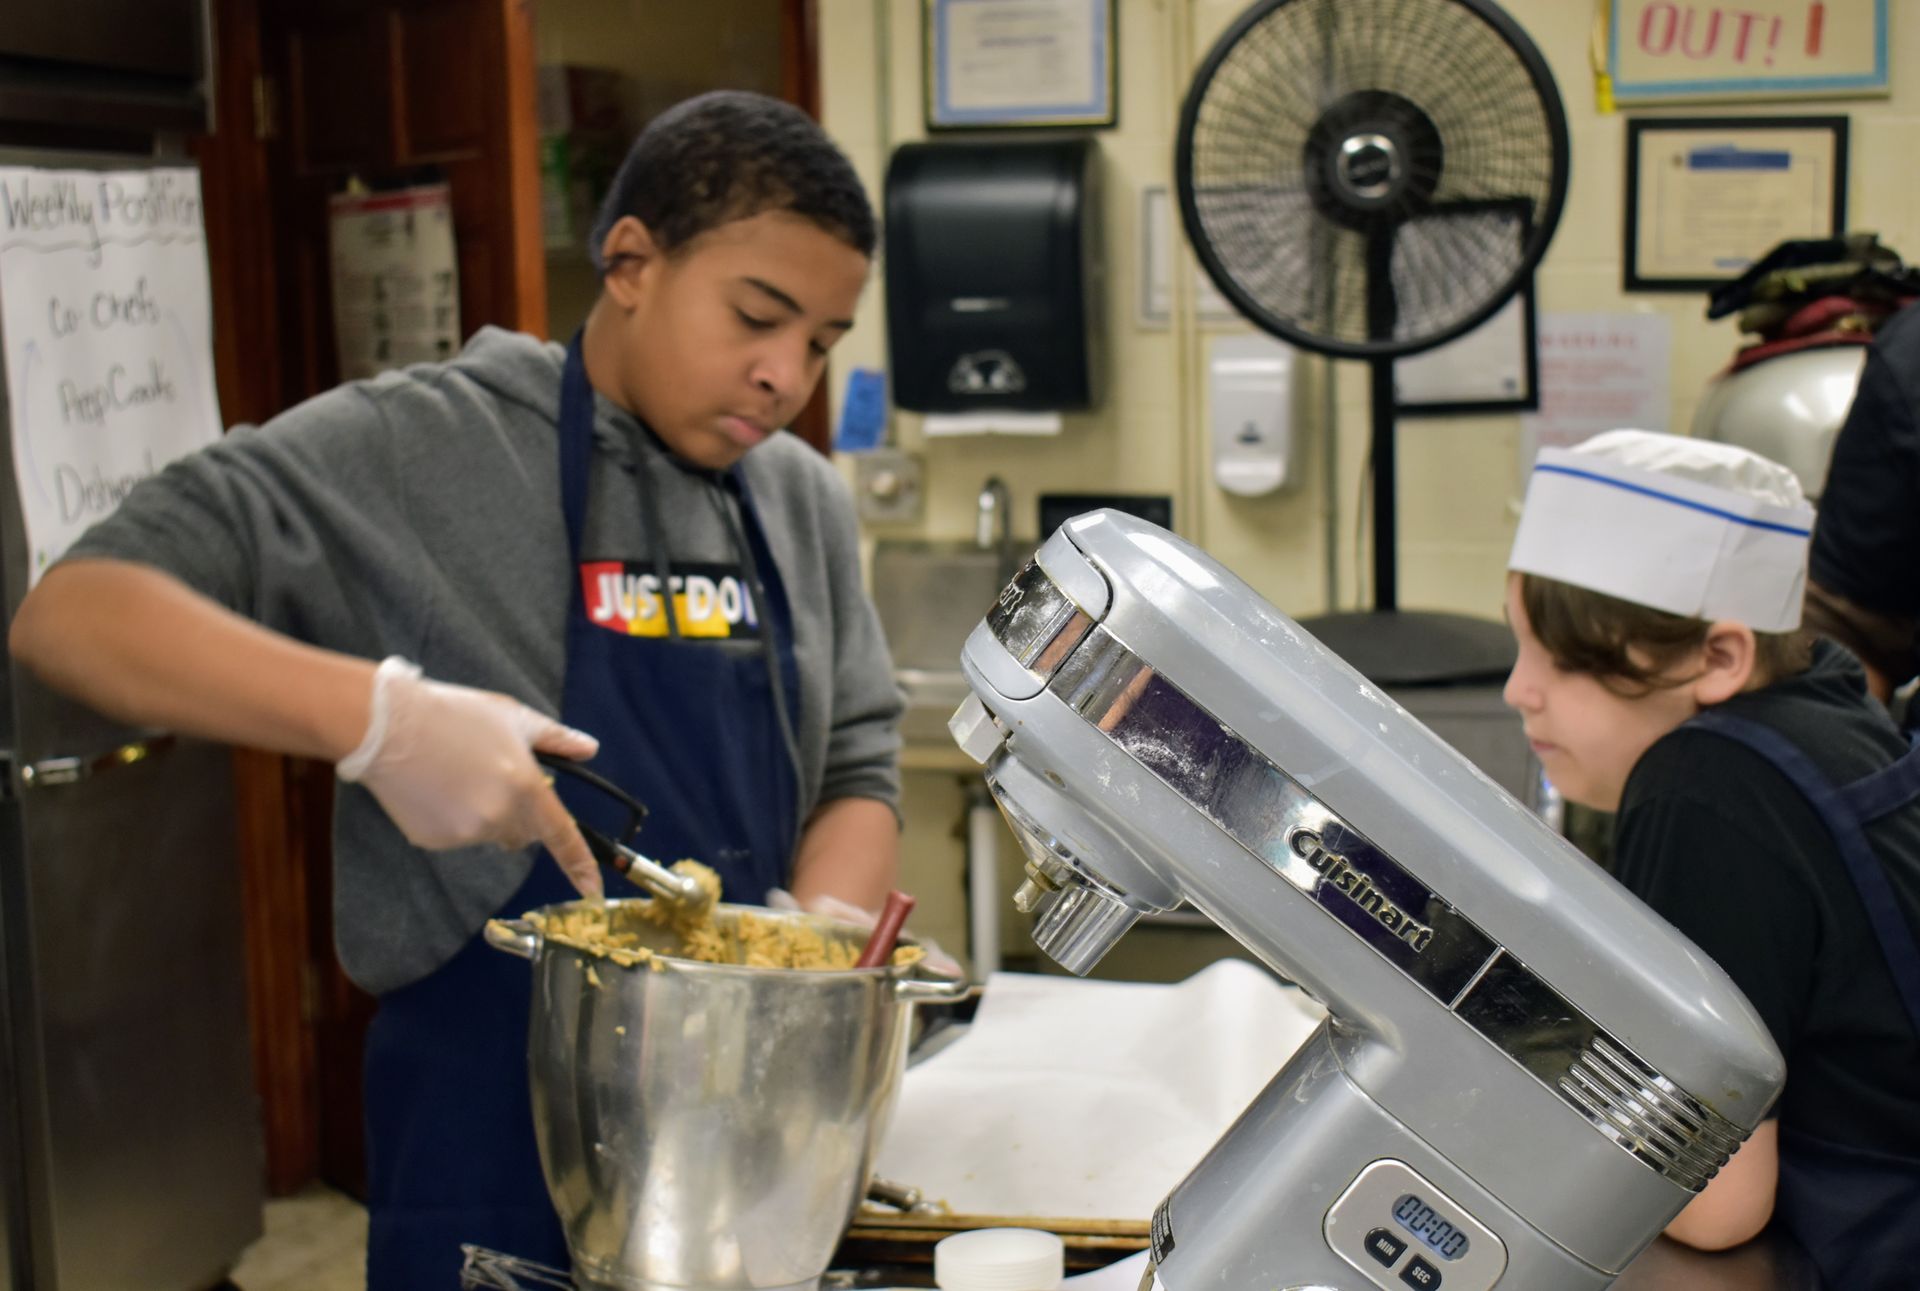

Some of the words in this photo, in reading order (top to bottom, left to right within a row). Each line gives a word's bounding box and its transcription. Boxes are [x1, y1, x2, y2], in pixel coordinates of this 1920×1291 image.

[1637, 1, 1783, 66] OUT!
[1, 176, 102, 270] Weekly
[684, 574, 742, 624] DO
[1284, 825, 1434, 953] Cuisinart
[1375, 1237, 1397, 1257] MIN
[1395, 1195, 1466, 1257] 00:00
[1411, 1265, 1432, 1284] SEC
